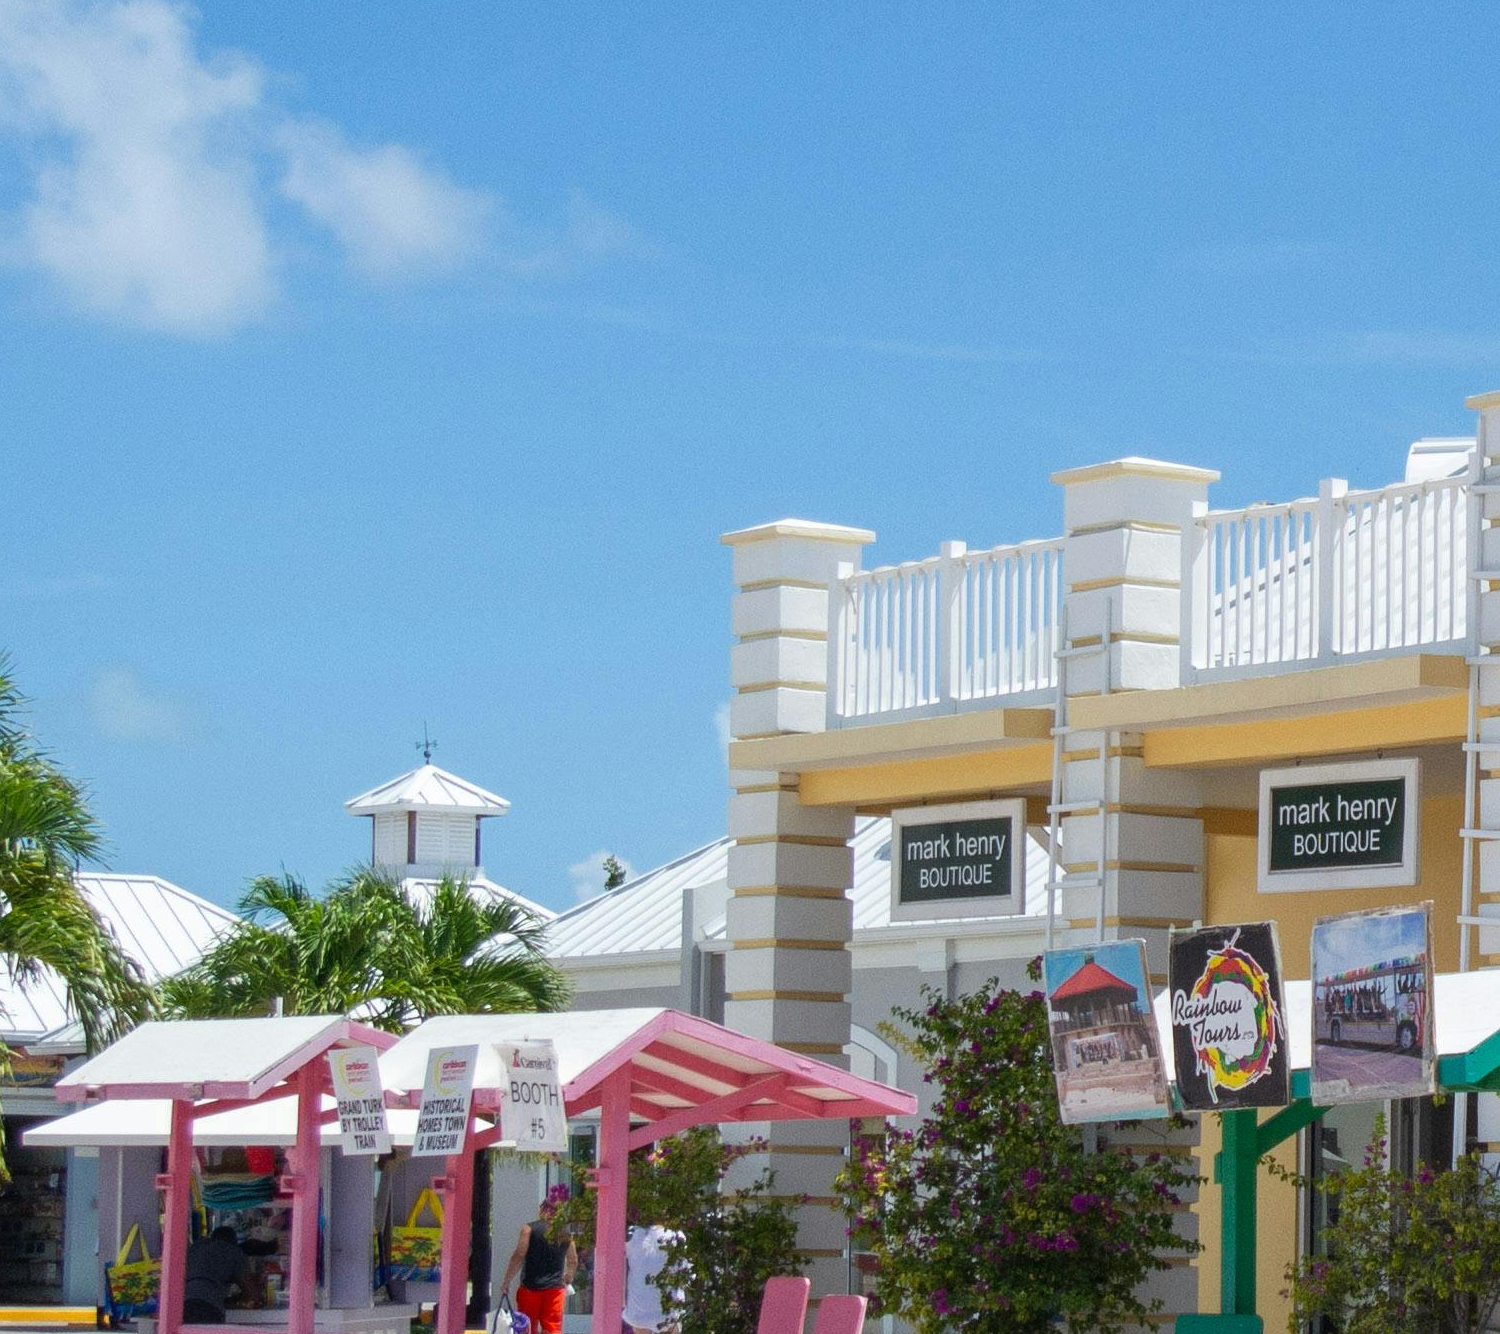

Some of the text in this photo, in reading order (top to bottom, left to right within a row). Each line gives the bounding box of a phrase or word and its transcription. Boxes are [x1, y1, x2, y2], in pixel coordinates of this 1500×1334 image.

[1278, 795, 1398, 826] mark henry
[906, 829, 1007, 862] mark henry
[1292, 828, 1381, 857] BOUTIQUE
[918, 864, 993, 889] BOUTIQUE
[1174, 988, 1242, 1021] Rainbow
[1193, 1018, 1242, 1044] Tours
[510, 1081, 560, 1107] BOOTH
[338, 1098, 384, 1116] GRAND TURK
[422, 1098, 465, 1116] HISTORICAL
[341, 1116, 384, 1133] BY TROLLEY
[418, 1116, 466, 1133] HOMES TOWN
[530, 1117, 546, 1140] #5
[354, 1134, 377, 1149] TRAIN
[425, 1134, 459, 1149] MUSEUM
